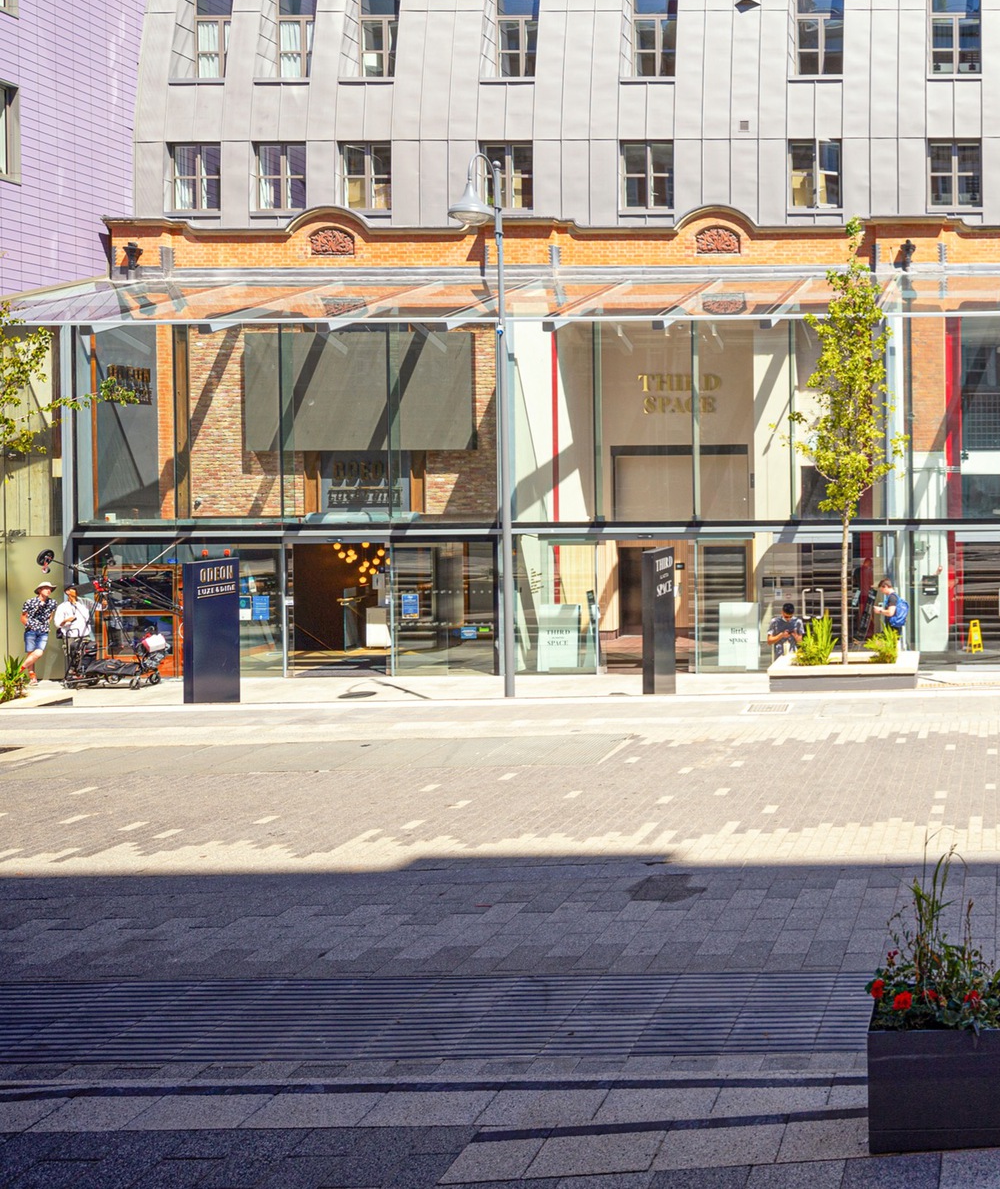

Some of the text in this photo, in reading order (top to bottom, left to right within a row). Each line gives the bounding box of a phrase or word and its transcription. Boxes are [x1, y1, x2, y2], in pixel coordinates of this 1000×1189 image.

[655, 555, 673, 572] THIRD
[200, 565, 233, 583] ODEON
[656, 579, 673, 597] SPACE
[730, 627, 747, 635] little
